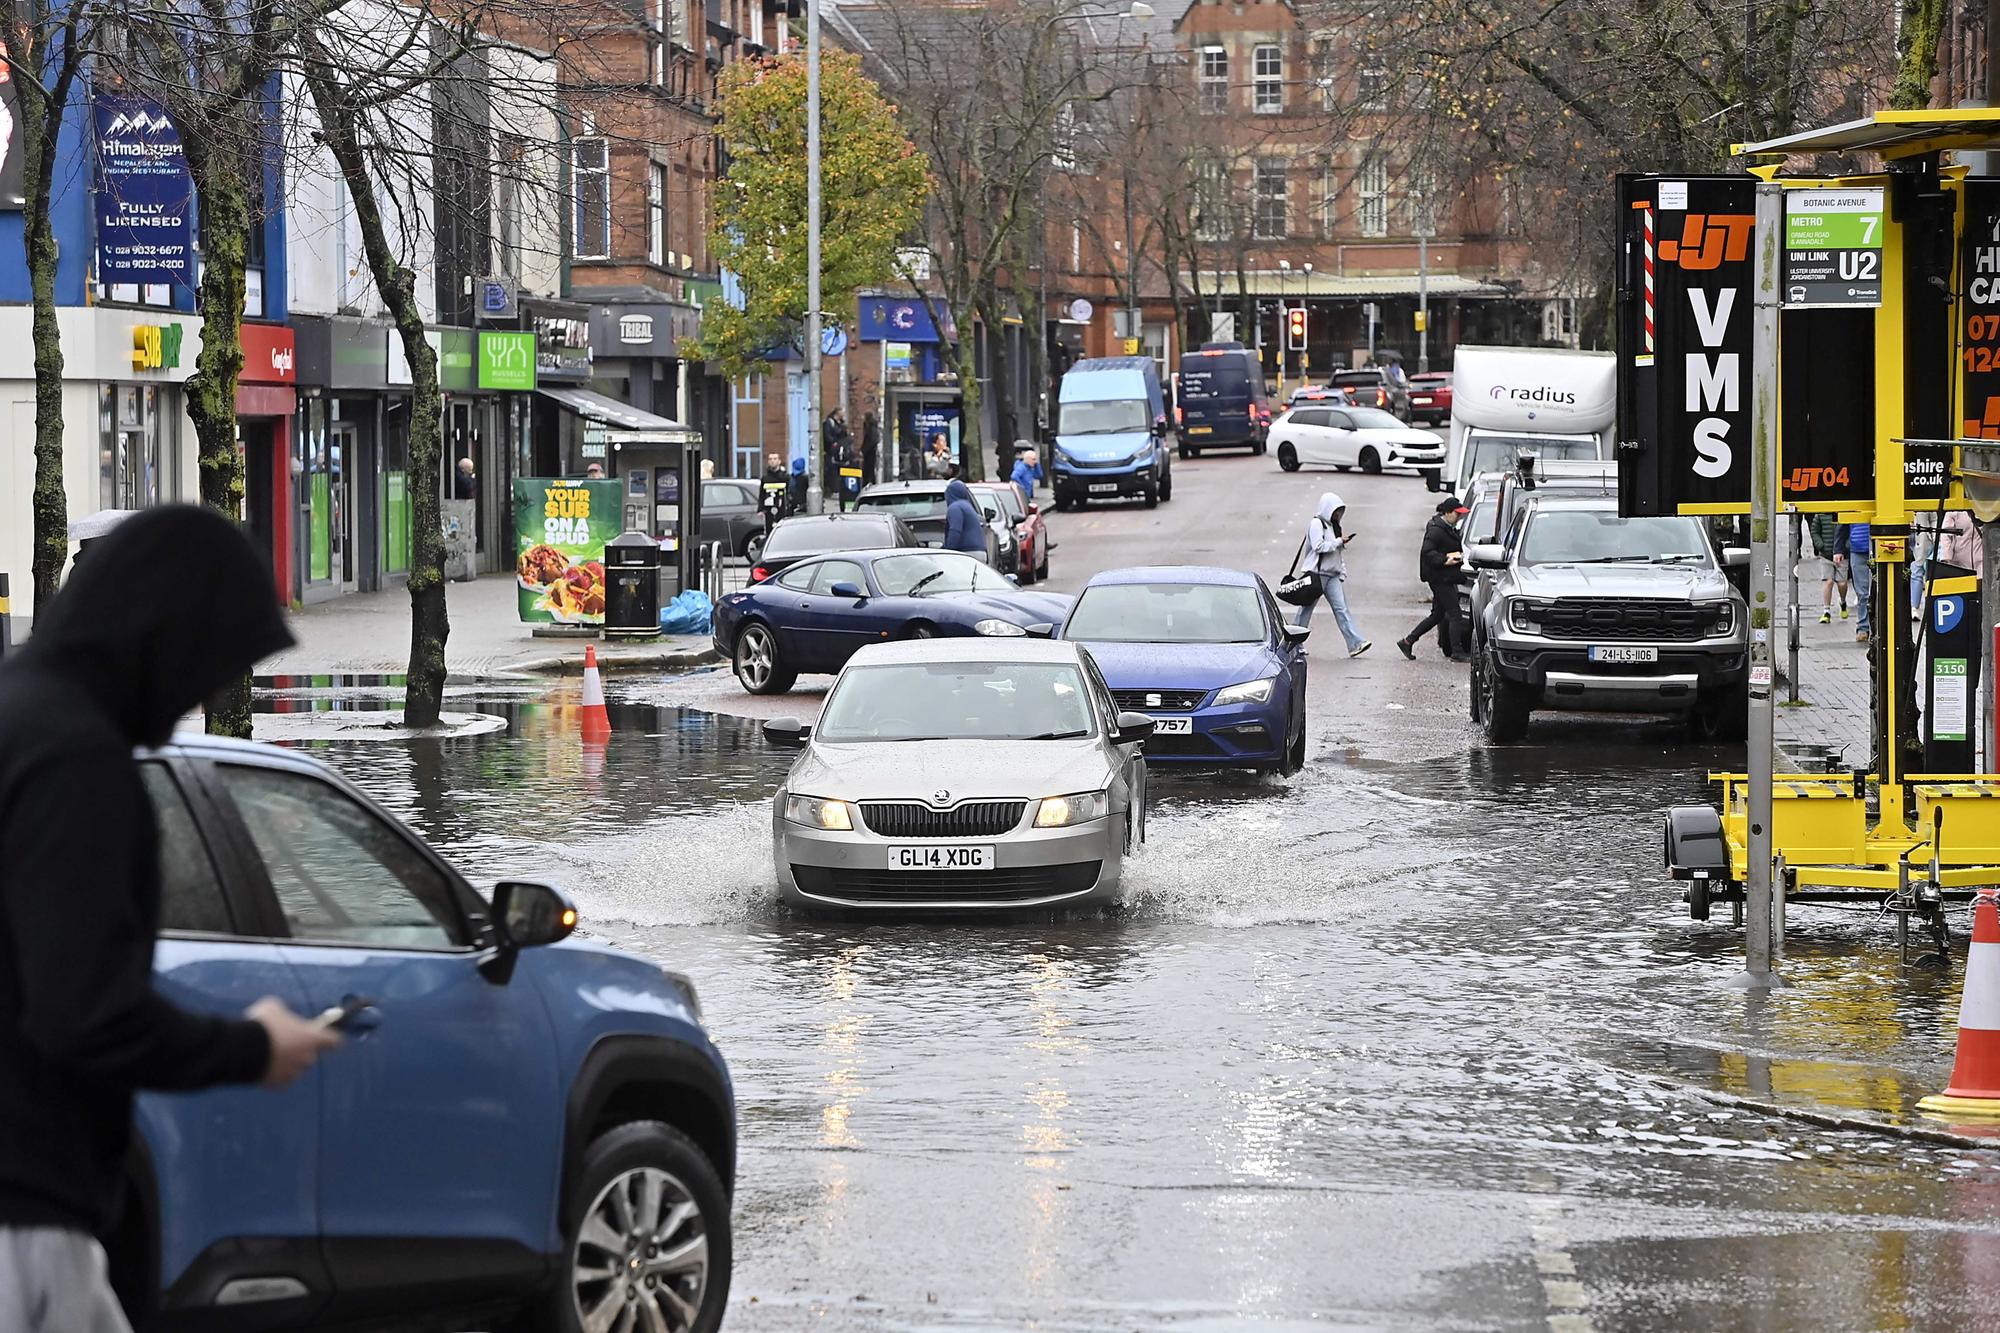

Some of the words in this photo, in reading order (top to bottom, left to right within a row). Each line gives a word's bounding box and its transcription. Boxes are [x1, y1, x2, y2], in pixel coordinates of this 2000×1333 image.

[102, 140, 183, 159] Himalayan
[120, 203, 164, 213] FULLY
[1837, 198, 1866, 206] AVENUE
[106, 216, 181, 226] LICENSED
[1791, 217, 1823, 226] METRO
[1859, 216, 1878, 245] 7
[1658, 214, 1756, 270] JJT
[1790, 252, 1806, 261] UNI
[1808, 252, 1829, 261] LINK
[1839, 251, 1877, 280] U2
[619, 323, 653, 337] TRIBAL
[1511, 387, 1575, 404] radius
[848, 478, 857, 489] P
[1910, 475, 1943, 486] .co.uk
[545, 489, 590, 501] YOUR
[545, 502, 590, 518] SUB
[544, 518, 573, 532] ON
[575, 518, 590, 532] A
[545, 532, 590, 545] SPUD
[1938, 600, 1955, 625] P
[1602, 649, 1652, 660] 241-LS-1106
[1936, 665, 1965, 674] 3150
[900, 849, 940, 866] GL14
[947, 849, 982, 866] XDG
